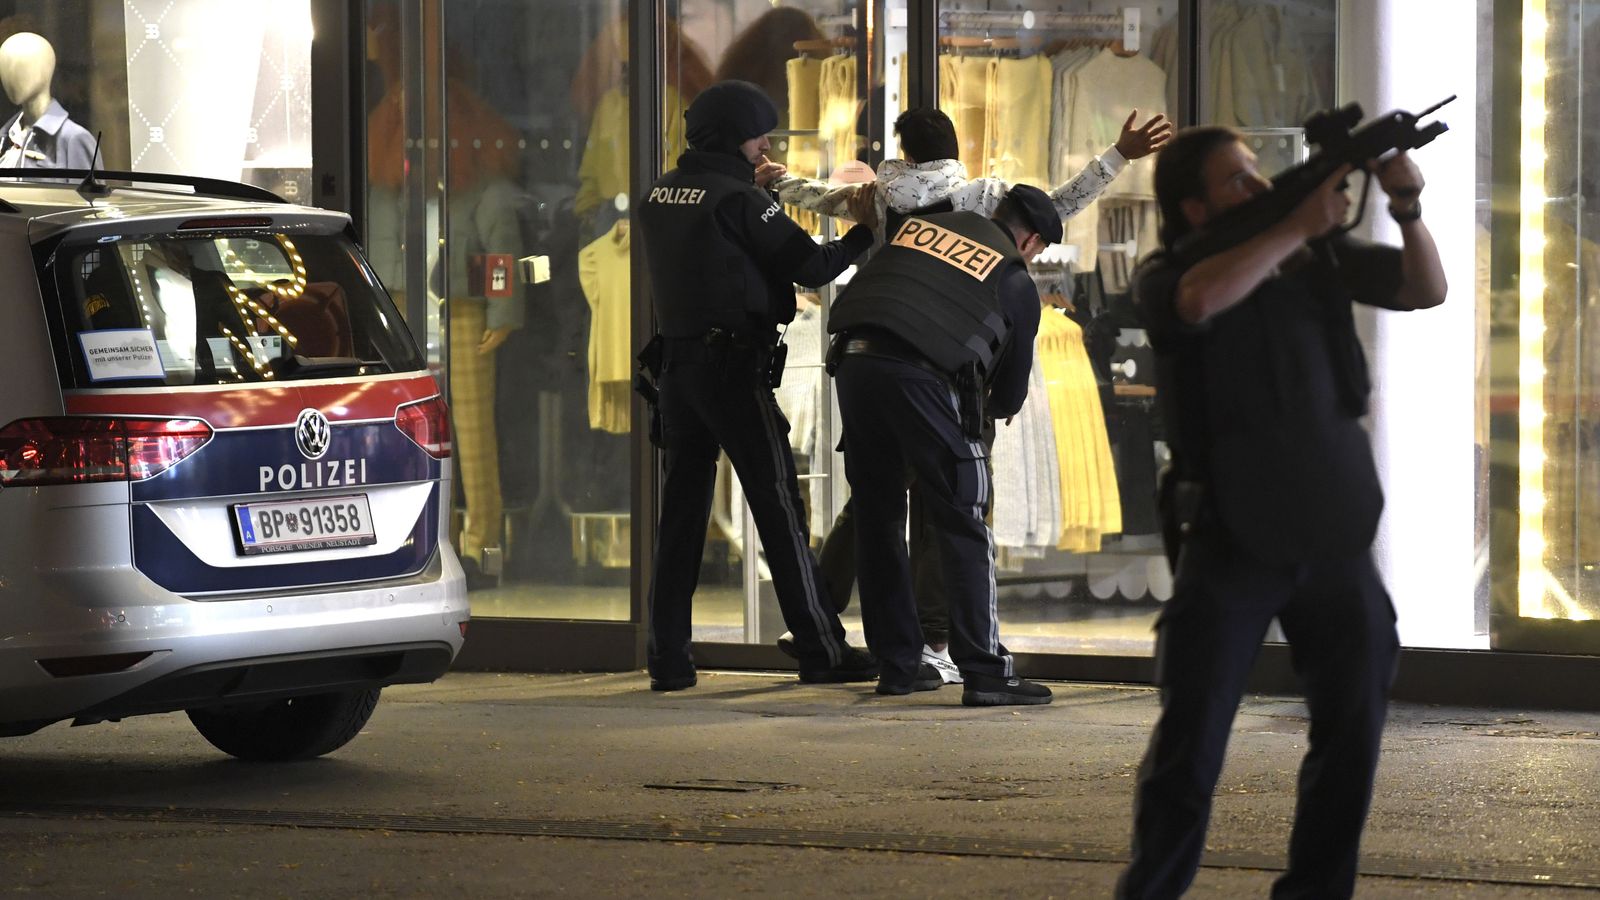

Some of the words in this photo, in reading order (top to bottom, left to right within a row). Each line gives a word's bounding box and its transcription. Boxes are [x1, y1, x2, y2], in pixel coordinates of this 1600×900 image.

[648, 187, 706, 204] POLIZEI
[897, 221, 997, 276] POLIZEI
[259, 458, 366, 491] POLIZEI
[246, 531, 252, 539] A
[299, 503, 361, 535] 91358
[261, 544, 294, 553] PORSCHE
[296, 542, 323, 550] WIENER
[326, 539, 361, 548] NEUSTADT
